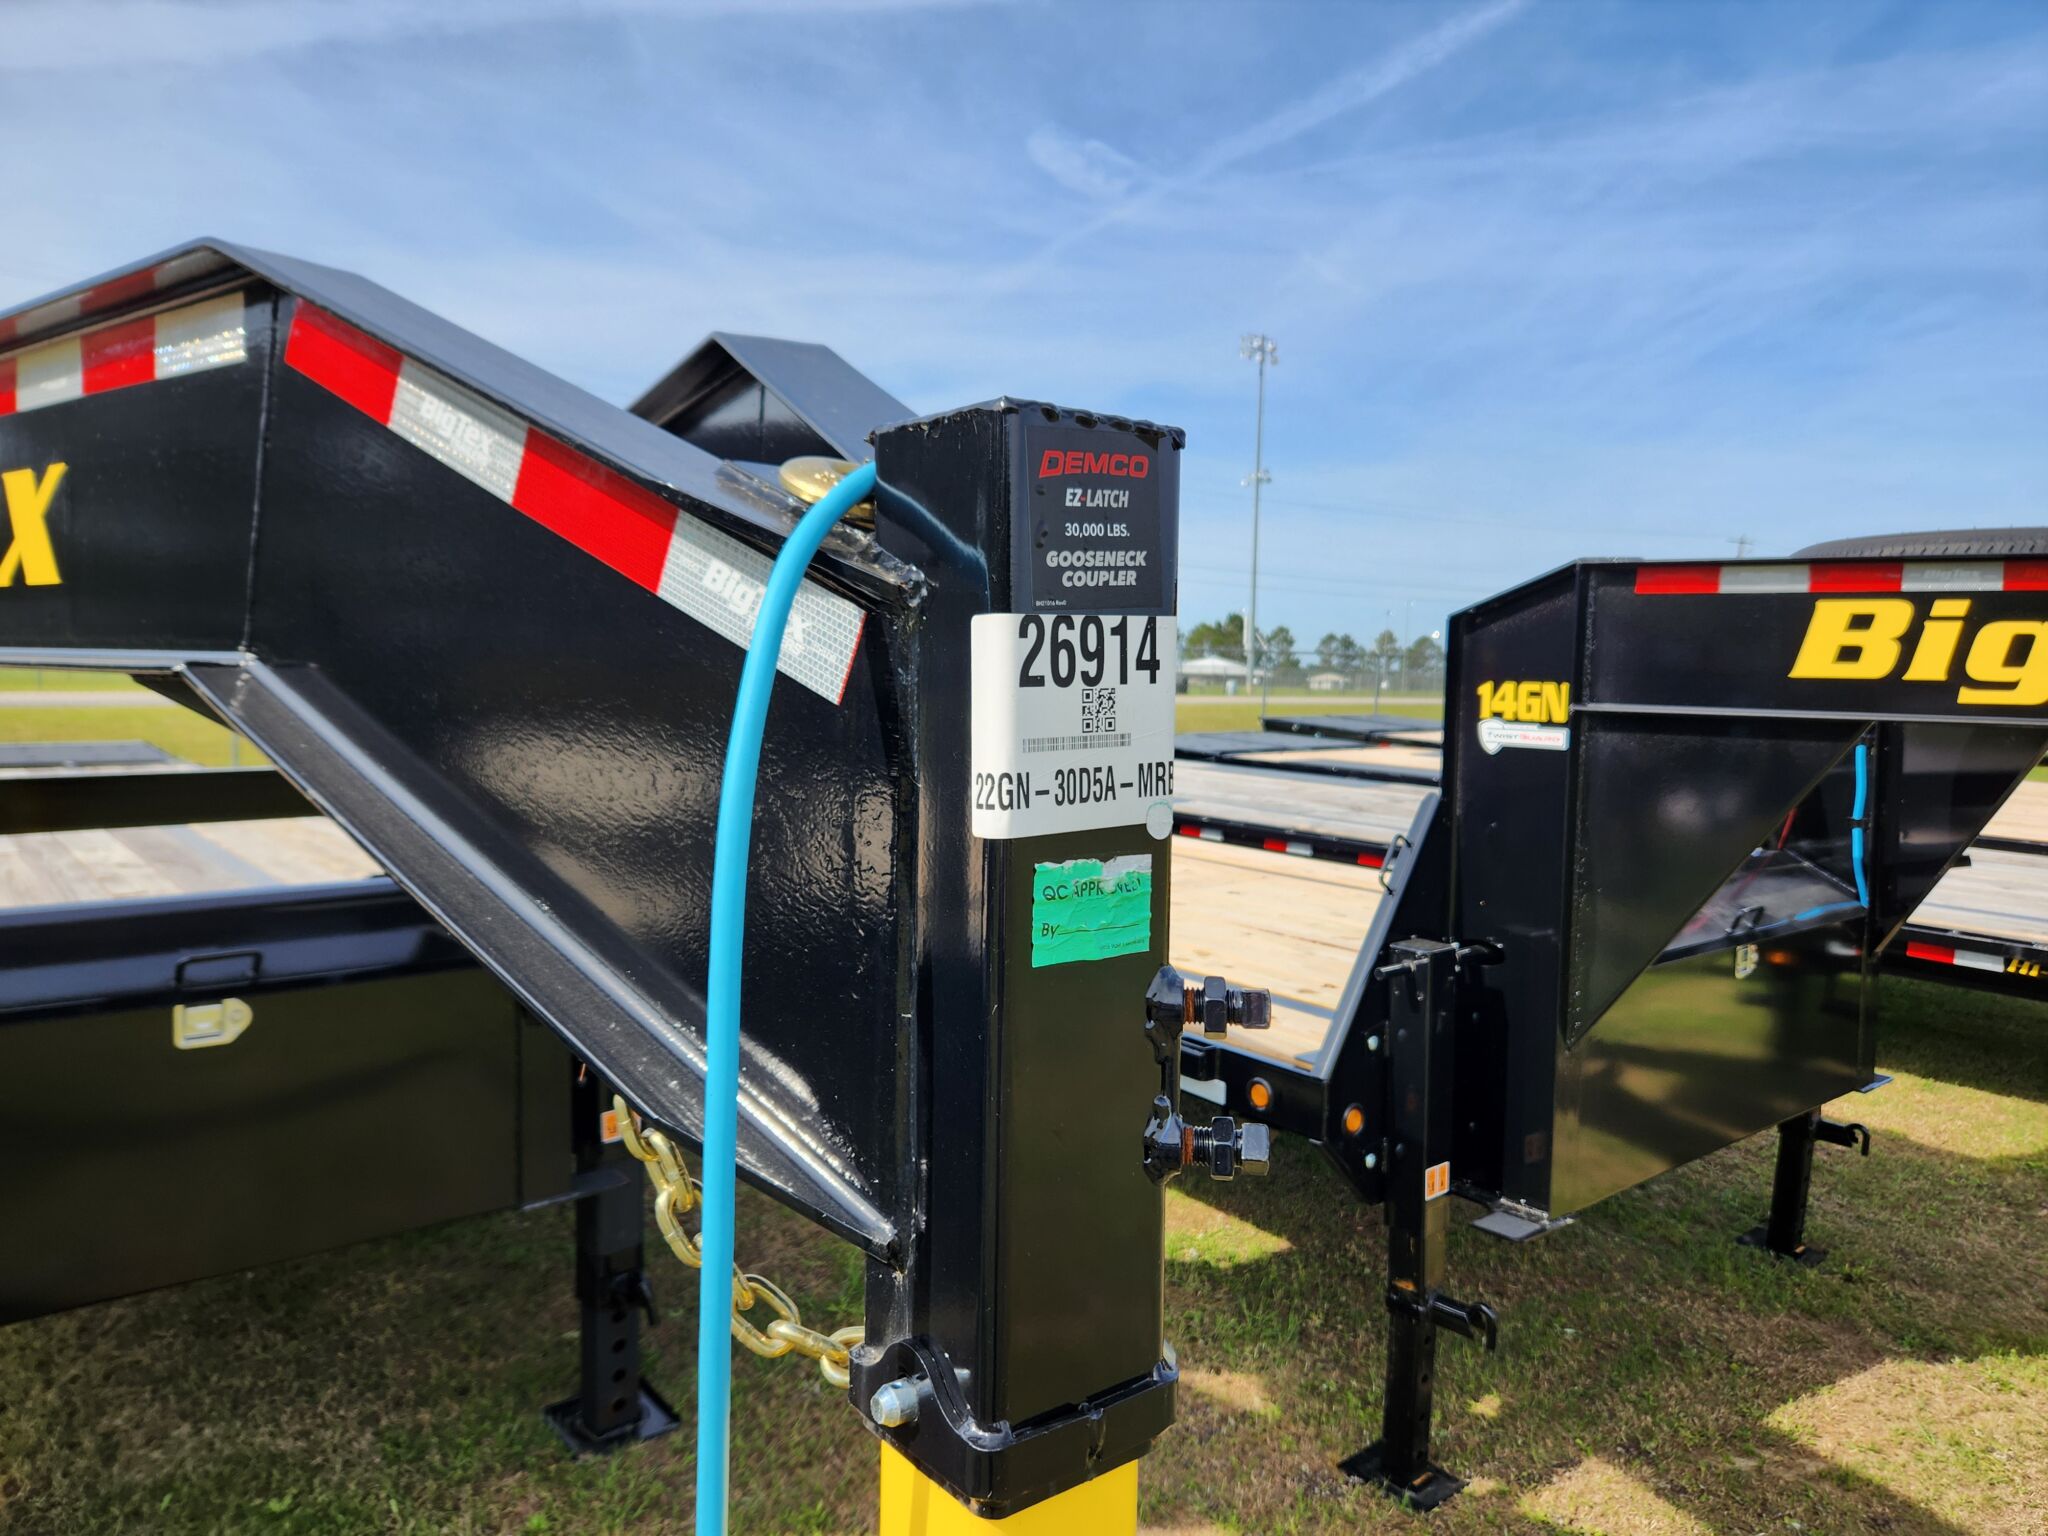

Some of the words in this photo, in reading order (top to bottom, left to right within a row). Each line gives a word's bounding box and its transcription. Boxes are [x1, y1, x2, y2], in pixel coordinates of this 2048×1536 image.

[1038, 450, 1150, 479] DEMCO
[1064, 487, 1130, 509] EZ-LATCH
[1064, 522, 1105, 539] 30,000
[1106, 524, 1131, 538] LBS.
[1046, 550, 1148, 568] GOOSENECK
[1061, 570, 1137, 588] COUPLER
[1018, 614, 1161, 688] 26914
[1787, 598, 2048, 706] Big
[1476, 680, 1570, 724] 14GN
[1042, 884, 1069, 902] QC
[1041, 922, 1060, 939] By
